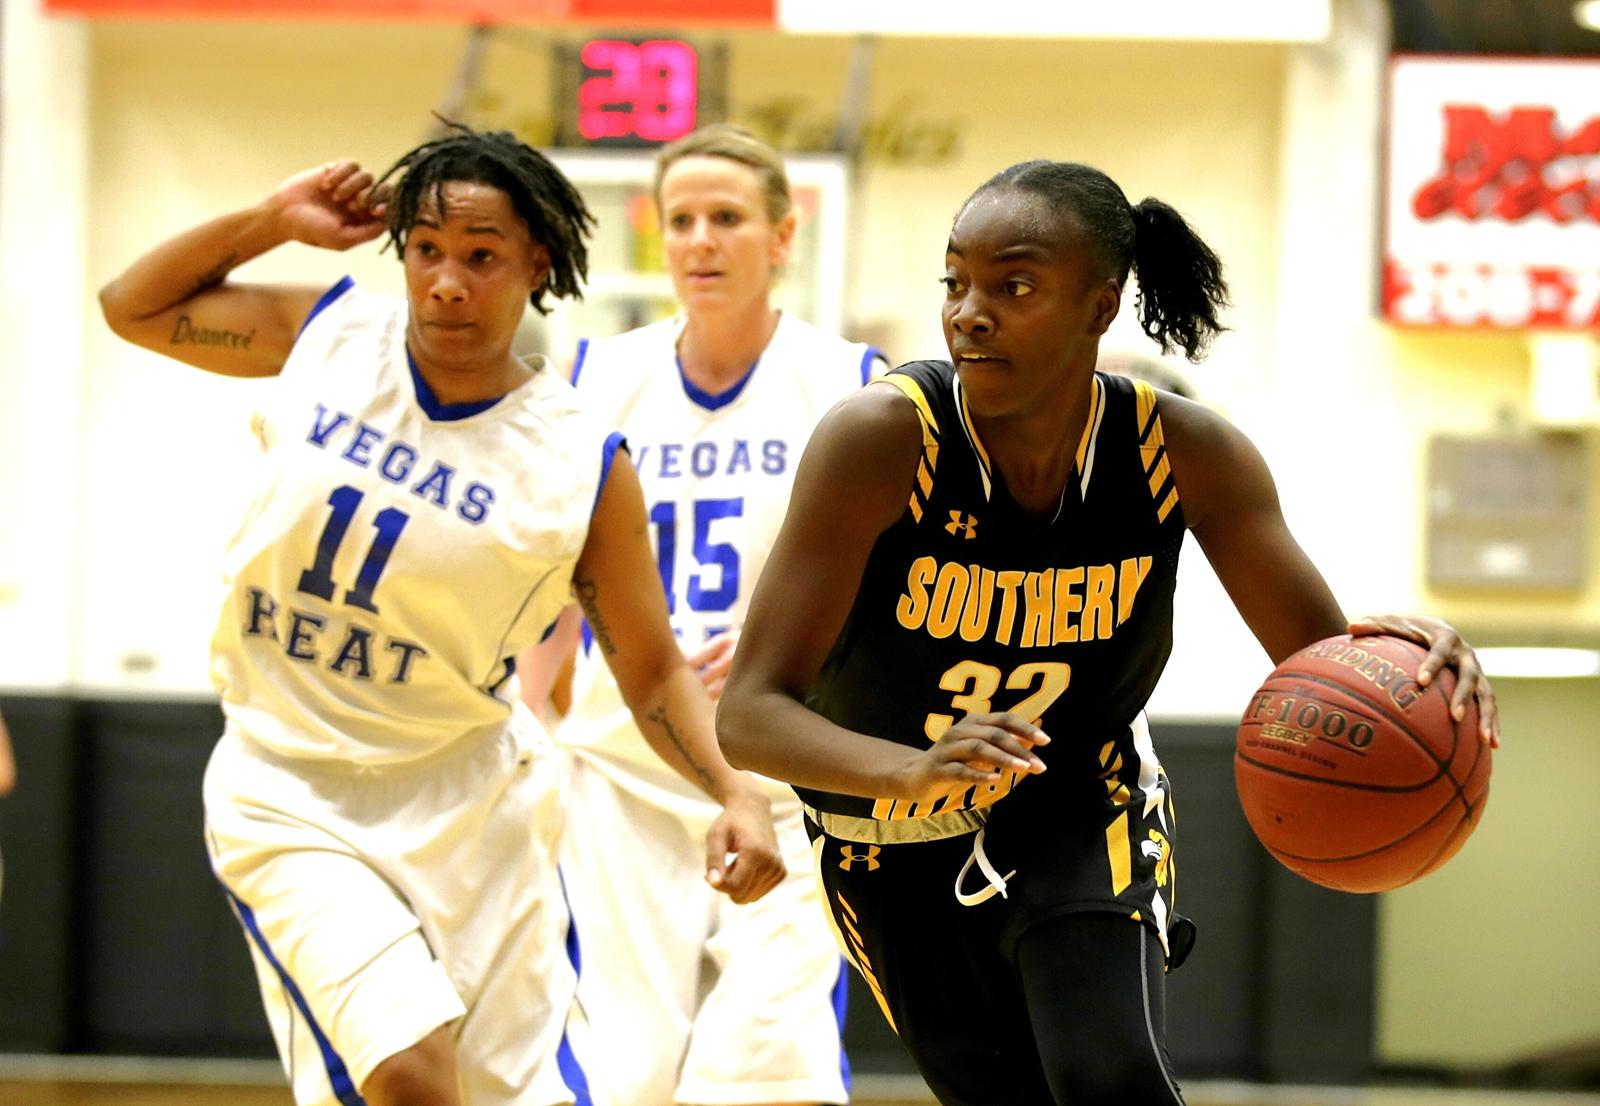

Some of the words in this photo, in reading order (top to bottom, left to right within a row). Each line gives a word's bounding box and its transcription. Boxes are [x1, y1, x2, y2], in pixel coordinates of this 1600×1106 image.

[305, 402, 496, 526] VEGAS
[297, 484, 410, 616] 11
[650, 497, 743, 615] 15
[243, 585, 431, 684] HEAT
[896, 556, 1153, 648] SOUTHERN
[924, 659, 1071, 743] 32
[1301, 642, 1425, 712] ALDING
